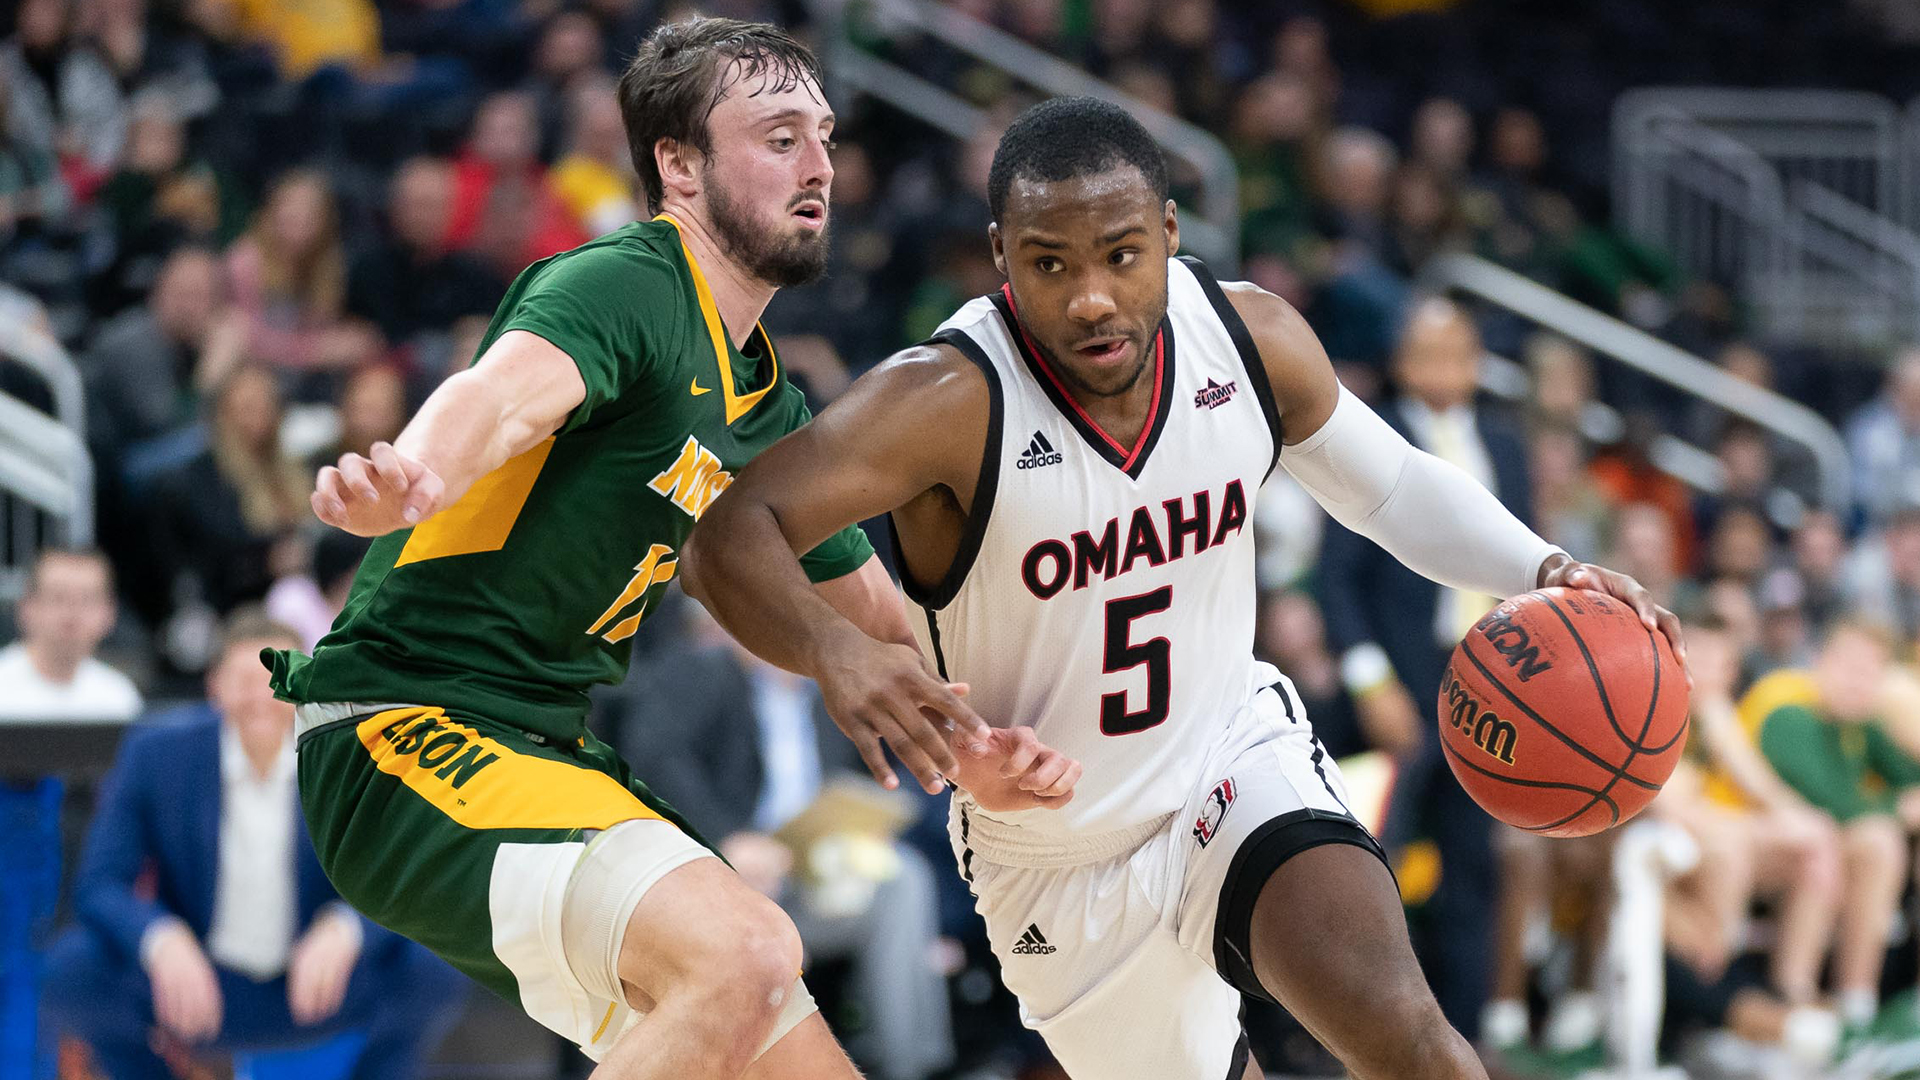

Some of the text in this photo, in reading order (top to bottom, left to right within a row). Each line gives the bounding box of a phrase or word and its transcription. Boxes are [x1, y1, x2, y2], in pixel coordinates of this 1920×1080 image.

[1194, 381, 1237, 409] SUMMIT
[1016, 453, 1063, 470] adidas
[1021, 478, 1247, 601] OMAHA
[1100, 584, 1173, 737] 5
[1442, 667, 1518, 767] Wilso
[1012, 943, 1057, 955] adidas
